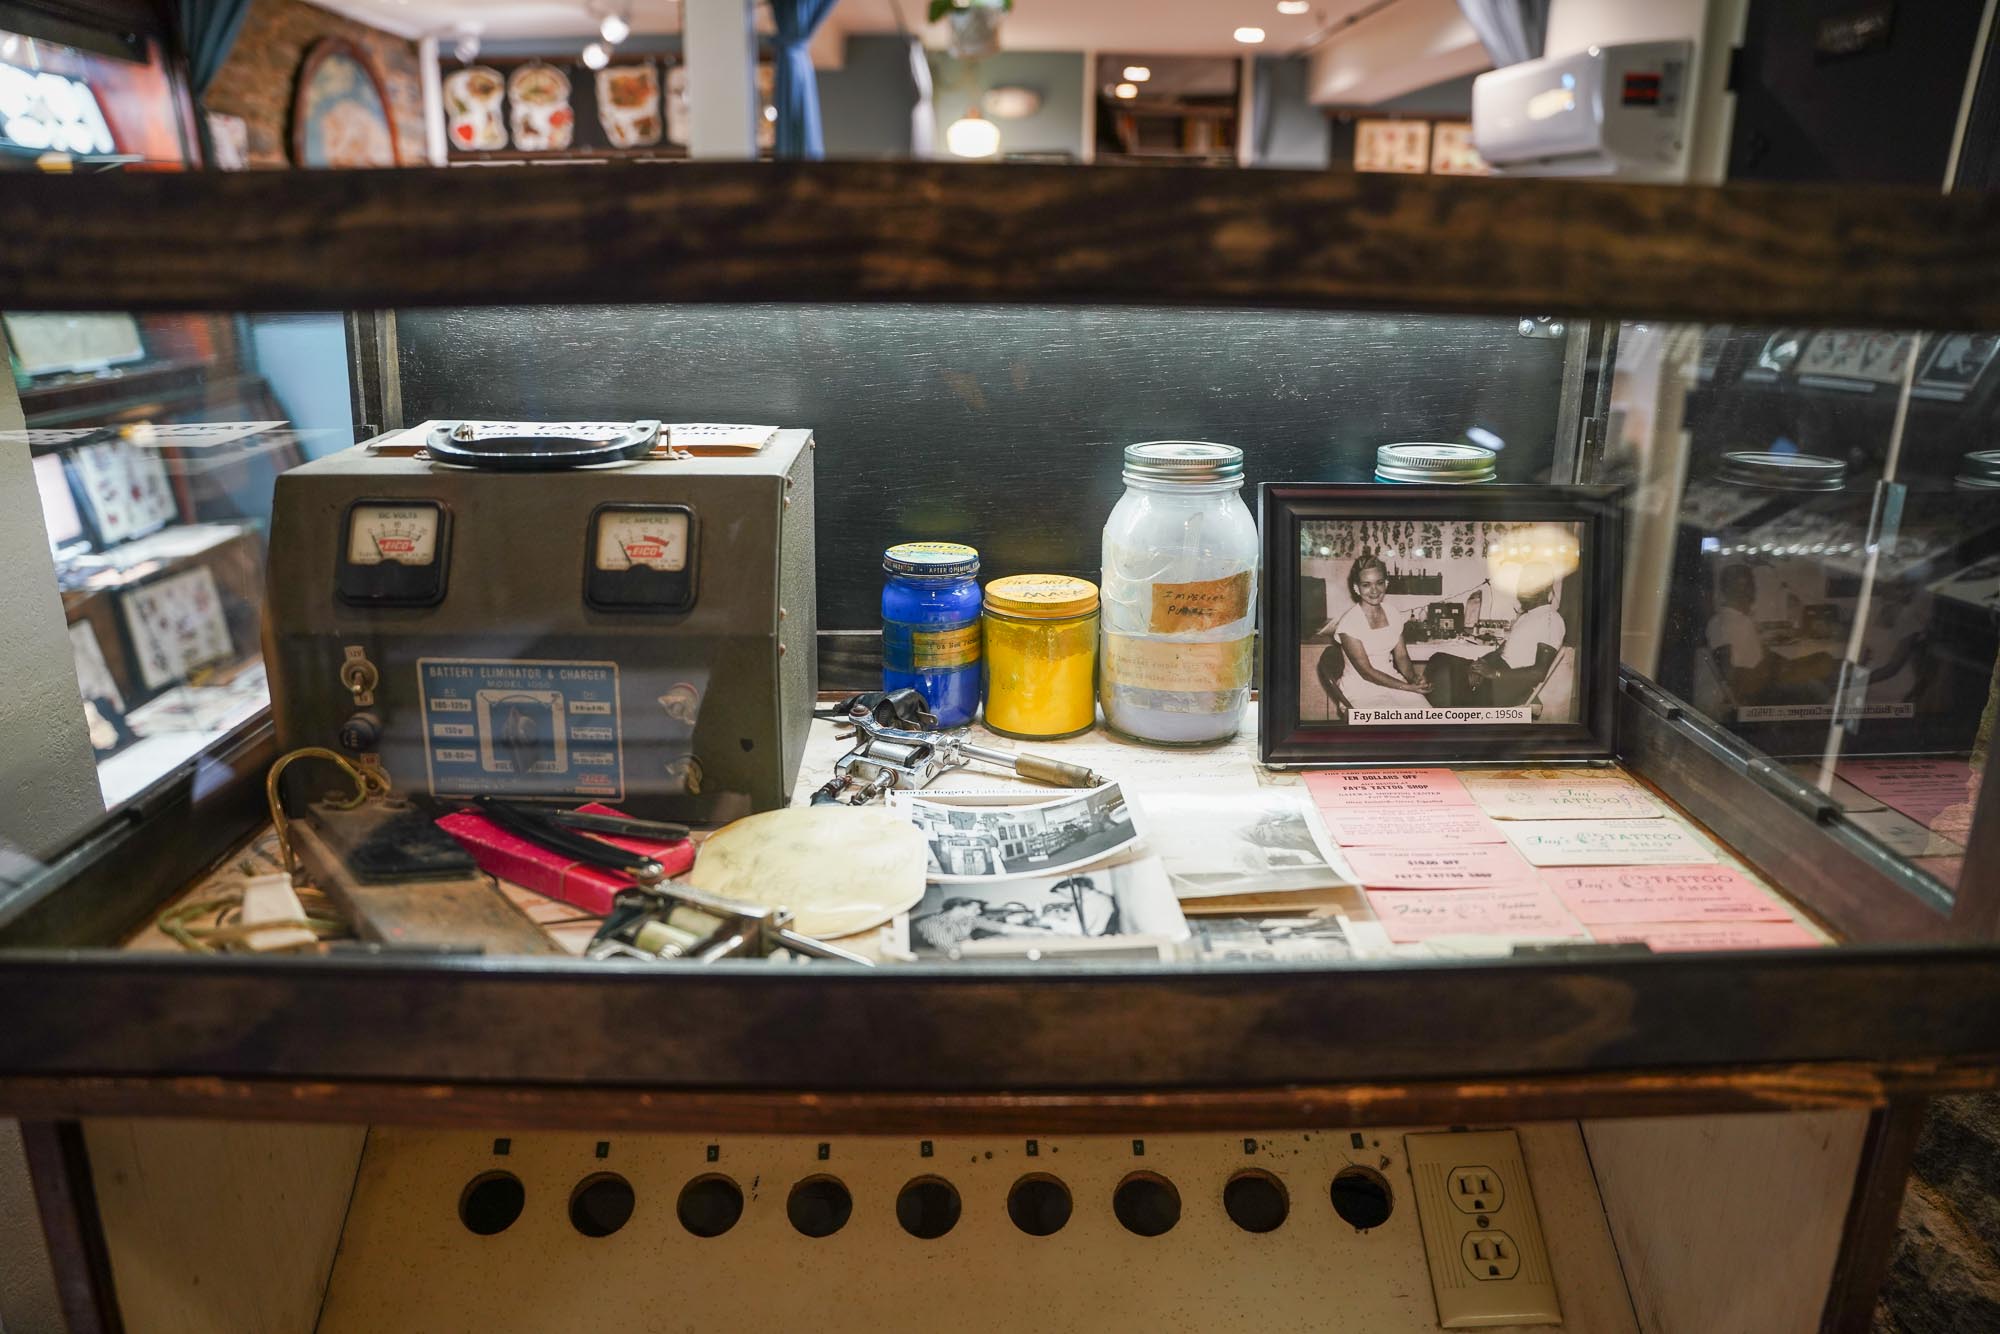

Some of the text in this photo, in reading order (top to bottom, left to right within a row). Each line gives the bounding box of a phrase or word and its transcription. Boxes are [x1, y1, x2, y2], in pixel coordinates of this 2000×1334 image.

[632, 546, 658, 556] EICO
[928, 566, 947, 574] AFTER
[429, 666, 608, 682] BATTERY ELIMINATOR & CHARGER
[487, 679, 524, 689] MODEL
[1354, 711, 1371, 722] Fay
[1374, 710, 1401, 720] Balch
[1404, 710, 1424, 720] and
[1425, 710, 1443, 720] Lee
[1446, 710, 1484, 722] Cooper,
[1495, 709, 1523, 719] 1950s
[1602, 832, 1682, 840] TATTOO
[1652, 875, 1734, 884] TATTOO
